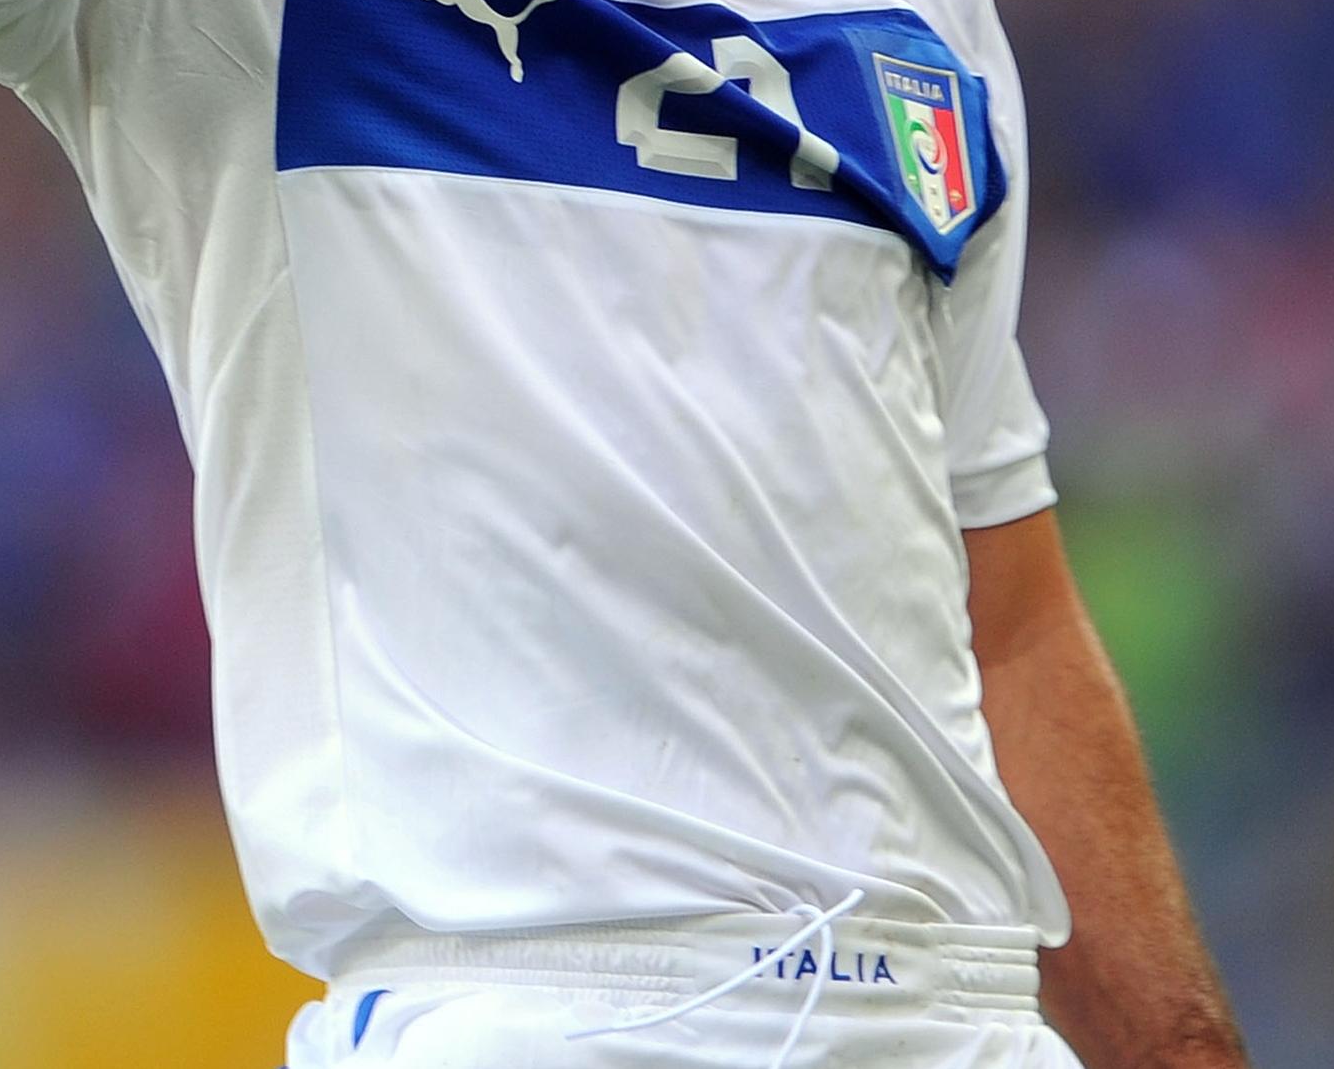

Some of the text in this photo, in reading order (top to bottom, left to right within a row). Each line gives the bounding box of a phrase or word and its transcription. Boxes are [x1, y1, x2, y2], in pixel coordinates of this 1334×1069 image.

[883, 70, 946, 103] ITALIA
[615, 34, 840, 192] 21
[752, 946, 898, 985] ITALIA
